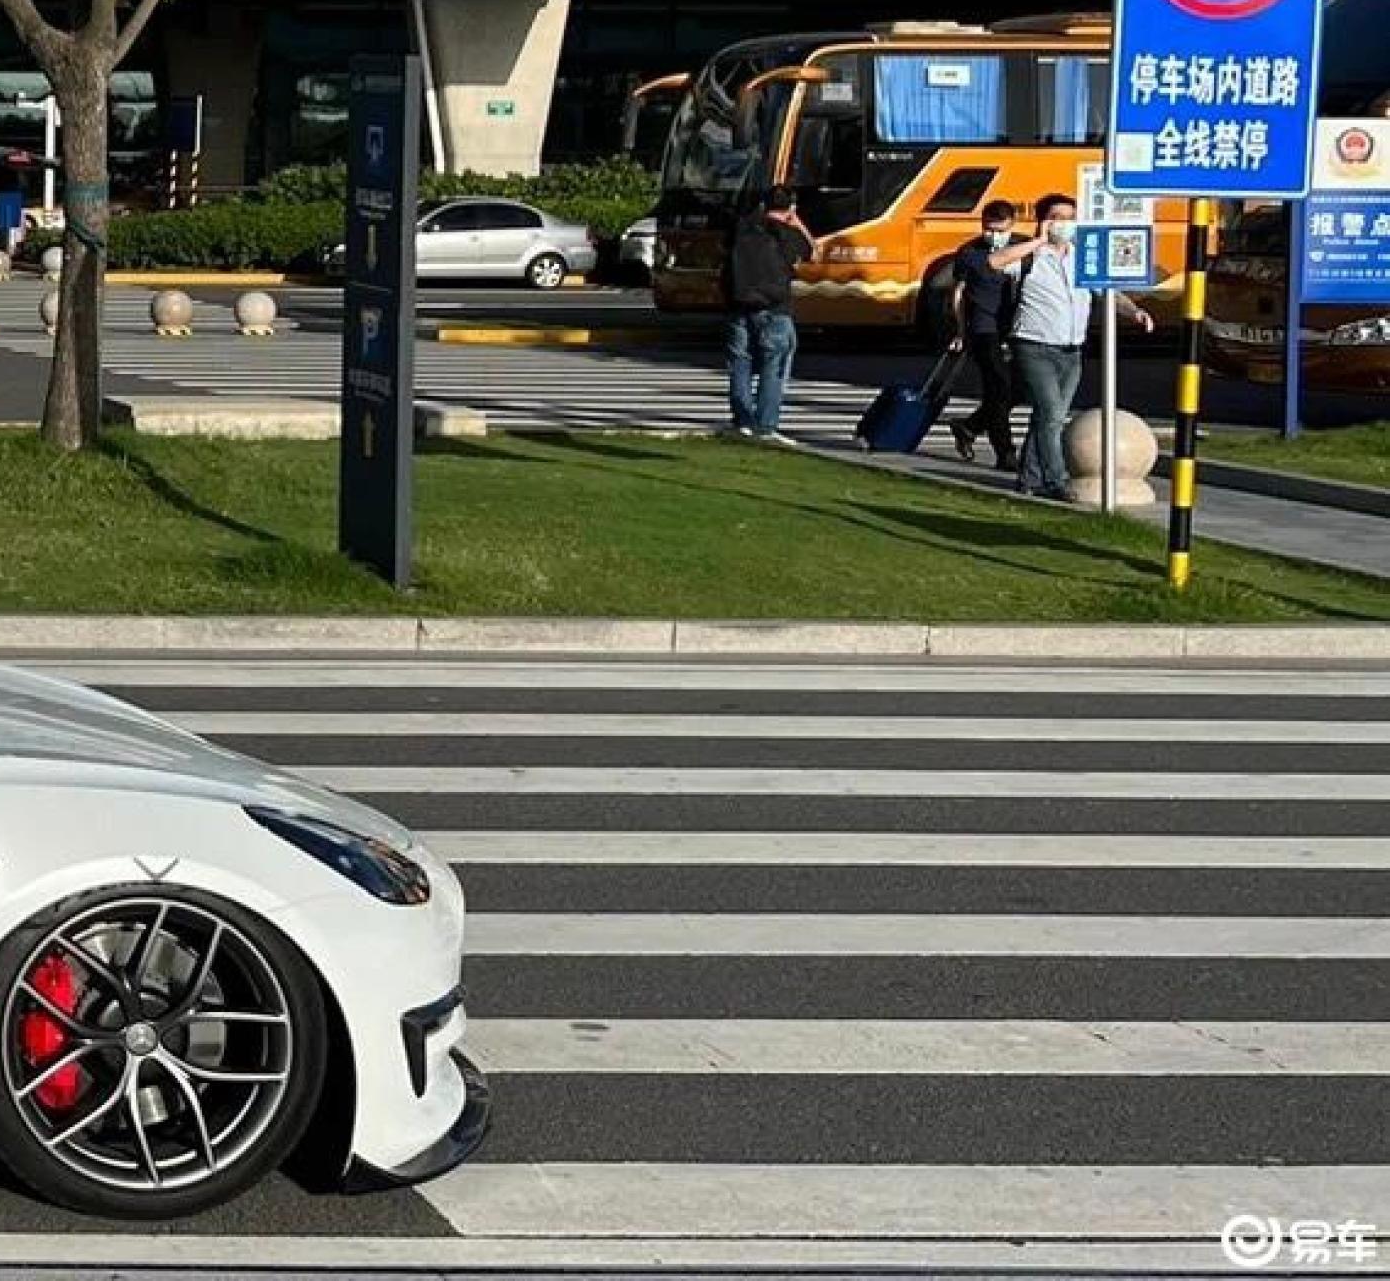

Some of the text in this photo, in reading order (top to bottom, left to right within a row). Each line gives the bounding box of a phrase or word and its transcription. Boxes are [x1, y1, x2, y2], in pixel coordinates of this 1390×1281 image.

[1130, 53, 1300, 106] 停车场内道路
[1154, 117, 1269, 170] 全线禁停
